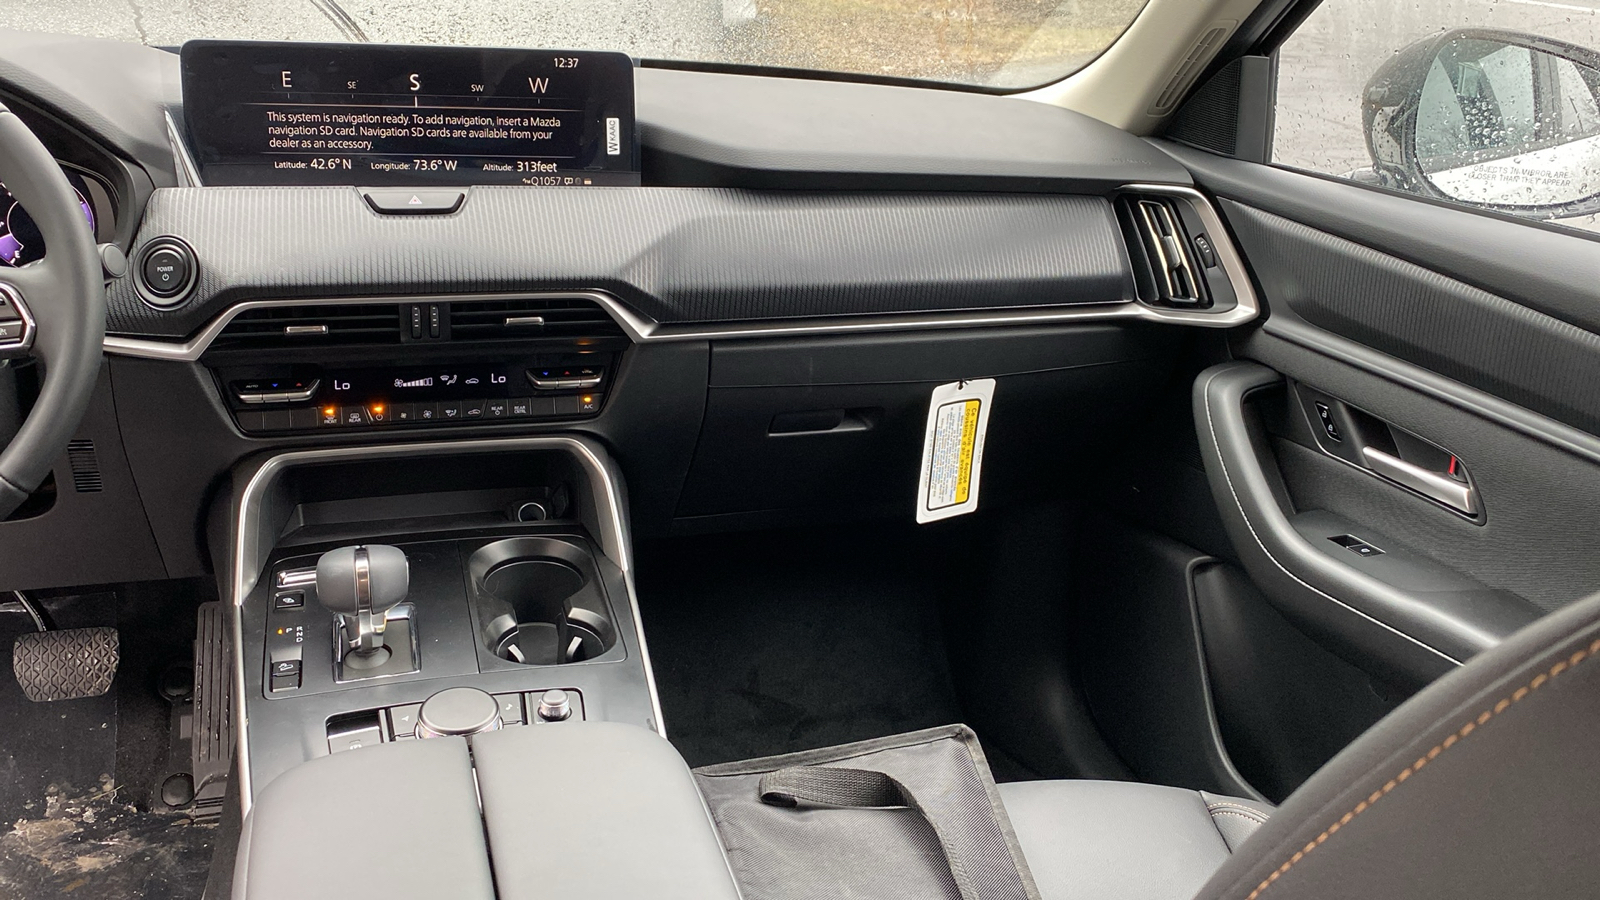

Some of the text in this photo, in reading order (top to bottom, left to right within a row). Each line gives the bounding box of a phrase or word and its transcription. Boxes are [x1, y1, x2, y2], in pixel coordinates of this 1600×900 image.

[554, 58, 579, 68] 12:37
[282, 71, 549, 94] E SE S SW W
[267, 112, 286, 122] This
[288, 112, 321, 124] system
[323, 112, 330, 122] is
[332, 113, 382, 124] navigation
[382, 114, 410, 126] ready.
[412, 114, 424, 124] To
[425, 114, 444, 125] add
[445, 116, 495, 127] navigation,
[496, 116, 522, 126] insert
[530, 117, 561, 127] Mazda
[268, 126, 553, 141] navigation SD card. Navigation SD cards are available from your
[269, 138, 374, 151] dealer as an accessory.
[274, 158, 352, 170] Latitude: 42.6° N
[370, 160, 458, 171] Longitude: 73.6° W
[483, 161, 558, 173] Altitude: 313feet
[1474, 165, 1508, 174] OBJECTS
[530, 176, 561, 186] Q1057
[1500, 174, 1520, 182] THAN
[1542, 178, 1571, 186] APPEAR
[491, 373, 506, 383] Lo
[334, 380, 351, 390] Lo
